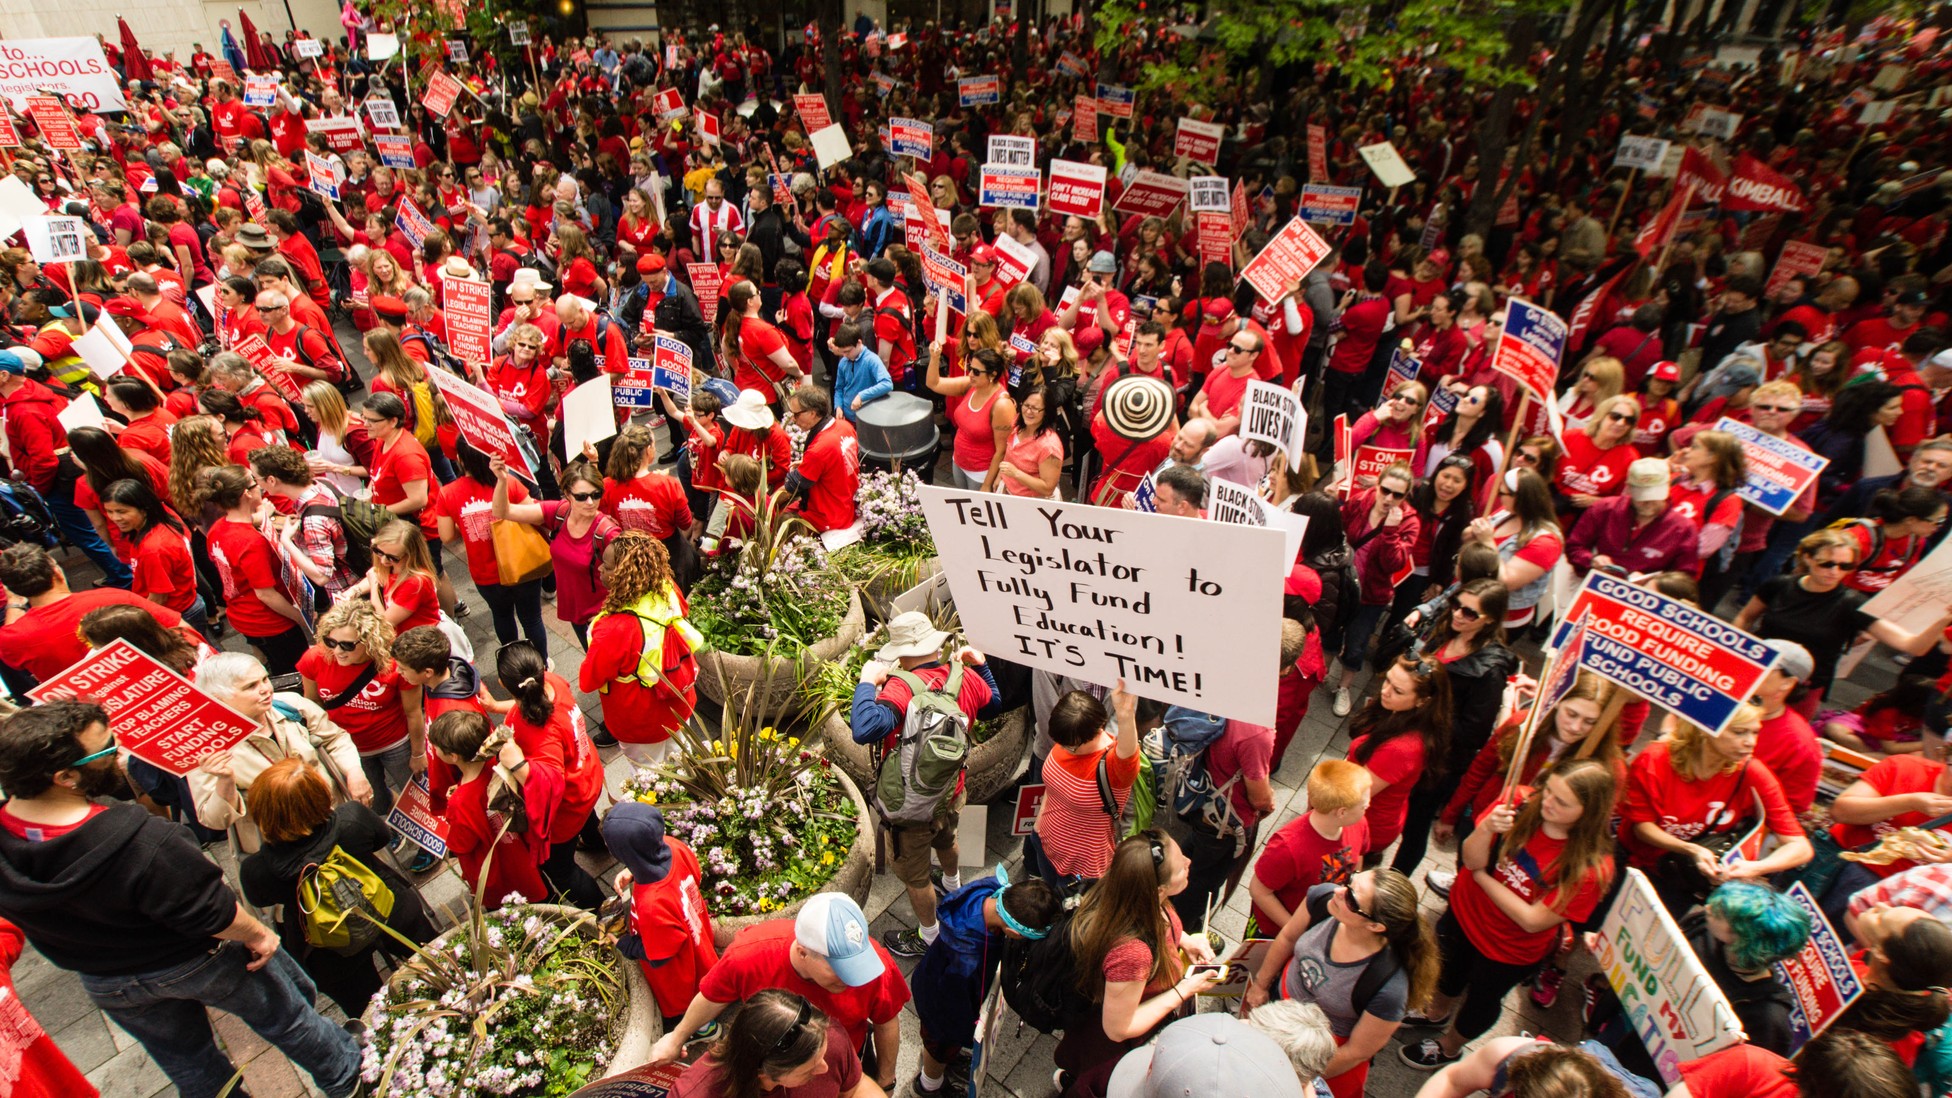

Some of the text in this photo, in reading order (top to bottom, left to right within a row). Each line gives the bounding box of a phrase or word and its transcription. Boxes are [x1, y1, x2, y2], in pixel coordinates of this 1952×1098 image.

[991, 138, 1006, 147] BLACK
[991, 148, 1030, 165] LIVES MATTER
[1728, 176, 1801, 212] KIMBALL
[1289, 221, 1326, 258] ON STRIKE
[445, 279, 488, 297] ON STRIKE
[446, 299, 488, 315] LEGISLATURE
[452, 320, 482, 332] TEACHERS
[456, 333, 479, 344] START
[239, 338, 265, 358] STRIKE
[453, 340, 484, 353] FUNDING
[660, 338, 683, 352] GOOD
[661, 358, 683, 373] GOOD
[664, 369, 684, 384] FUND
[614, 387, 643, 396] PUBLIC
[1252, 388, 1282, 410] BLACK
[1248, 405, 1281, 440] LIVES
[1375, 451, 1396, 463] ON
[1214, 502, 1247, 526] LIVES
[1216, 485, 1248, 509] BLACK
[945, 498, 1124, 544] Tell Your
[980, 535, 1223, 597] Legislator to
[977, 569, 1151, 615] Fully Fund
[1012, 604, 1184, 661] Education!
[1596, 578, 1767, 661] GOOD SCHOOLS
[1619, 608, 1715, 660] REQUIRE
[1013, 634, 1202, 698] IT'S TIME!
[1583, 630, 1715, 702] FUND PUBLIC
[1585, 612, 1641, 645] GOOD
[1640, 636, 1736, 692] FUNDING
[41, 645, 141, 703] ON STRIKE
[86, 673, 131, 701] Against
[1586, 652, 1684, 707] SCHOOLS
[127, 699, 193, 741] TEACHERS
[135, 684, 193, 720] BLAMING
[156, 717, 206, 750] START
[161, 719, 229, 762] FUNDING
[174, 725, 244, 770] SCHOOLS
[392, 811, 444, 853] GOOD SCHOOLS
[410, 804, 439, 832] REQUIRE
[1615, 925, 1659, 996] FUND
[1618, 873, 1743, 1058] FULLY
[1816, 930, 1857, 996] SCHOOLS
[1790, 963, 1824, 1025] FUNDING
[1659, 1000, 1687, 1040] MY
